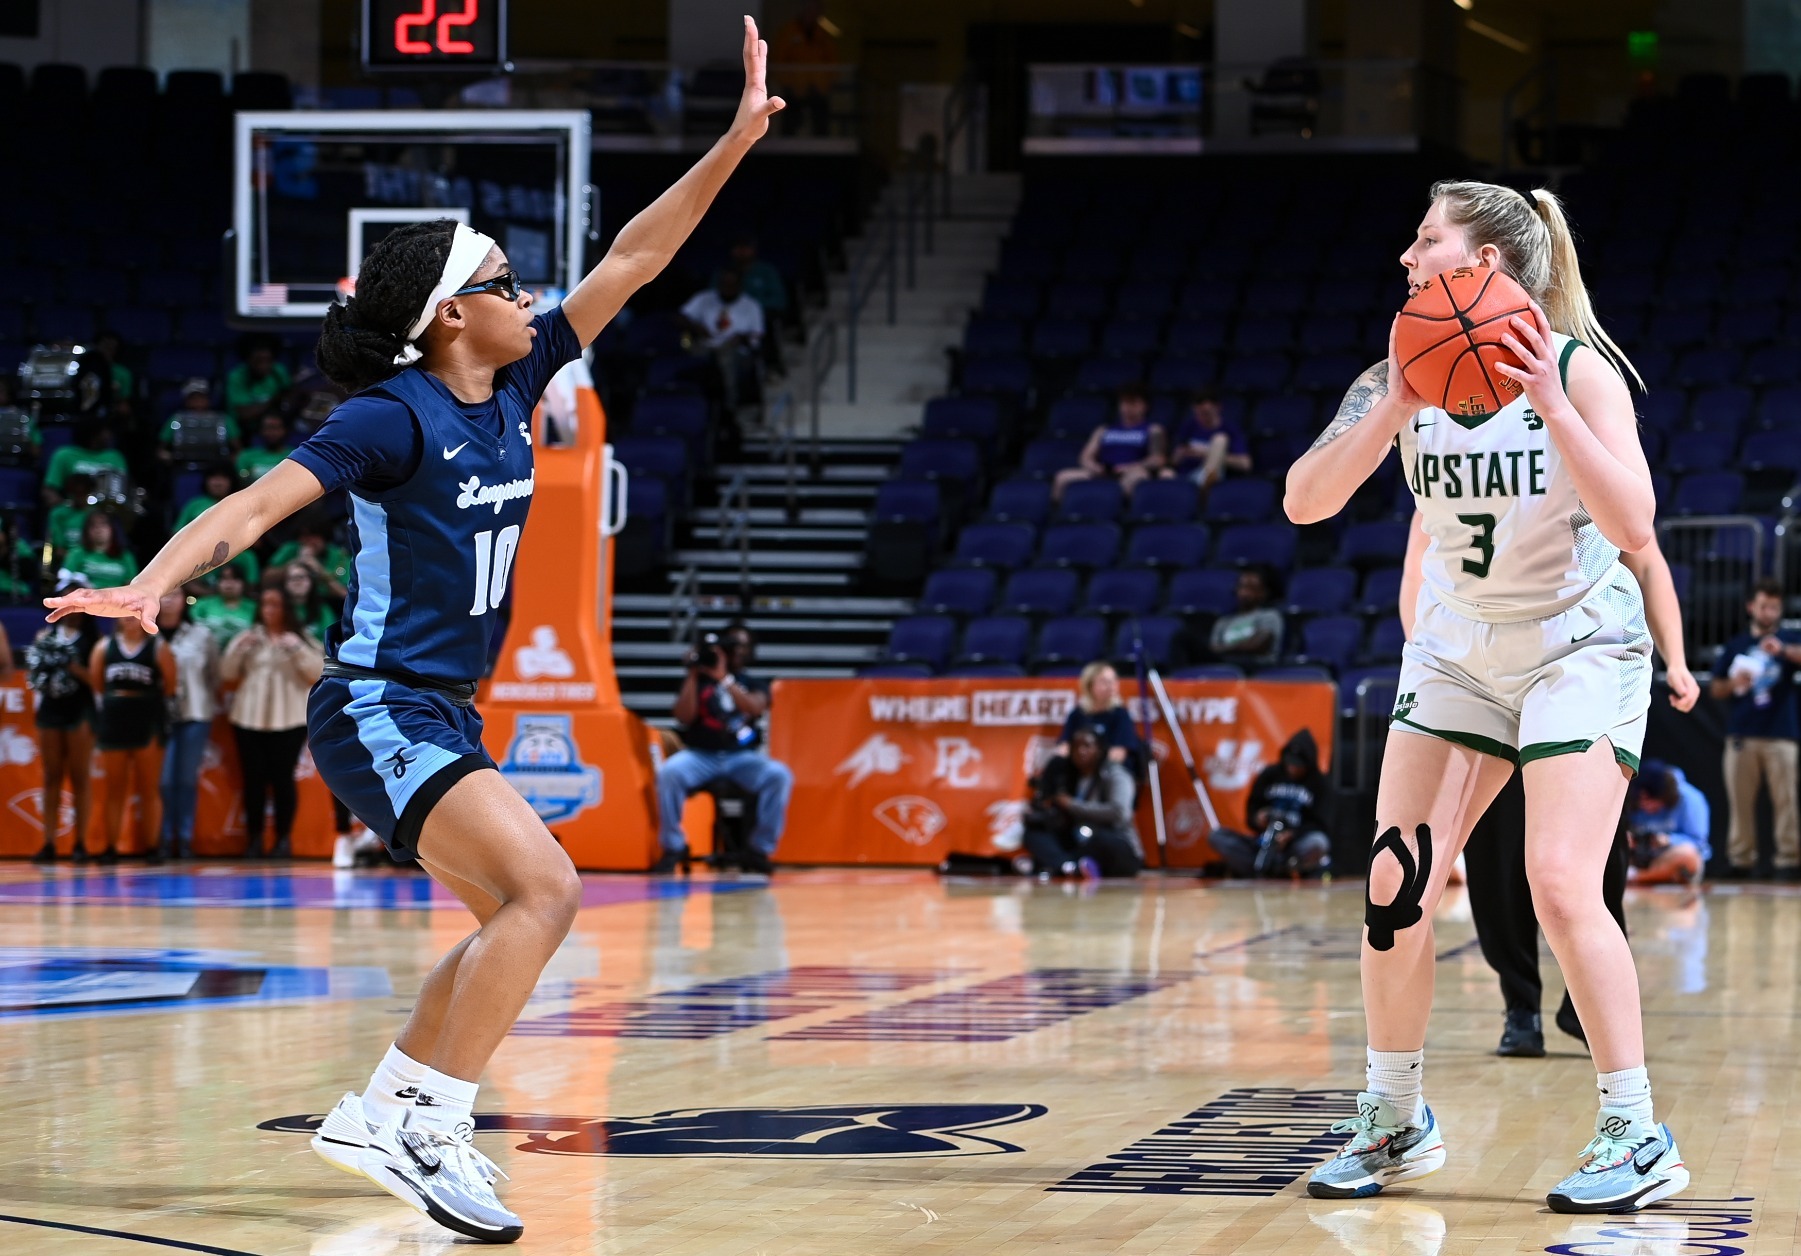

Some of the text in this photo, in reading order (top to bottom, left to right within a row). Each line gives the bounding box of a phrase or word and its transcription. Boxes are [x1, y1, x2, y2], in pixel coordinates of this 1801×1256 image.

[394, 0, 479, 54] 22
[469, 524, 520, 616] 10
[1456, 512, 1497, 580] 3
[870, 694, 1069, 722] WHERE HEART
